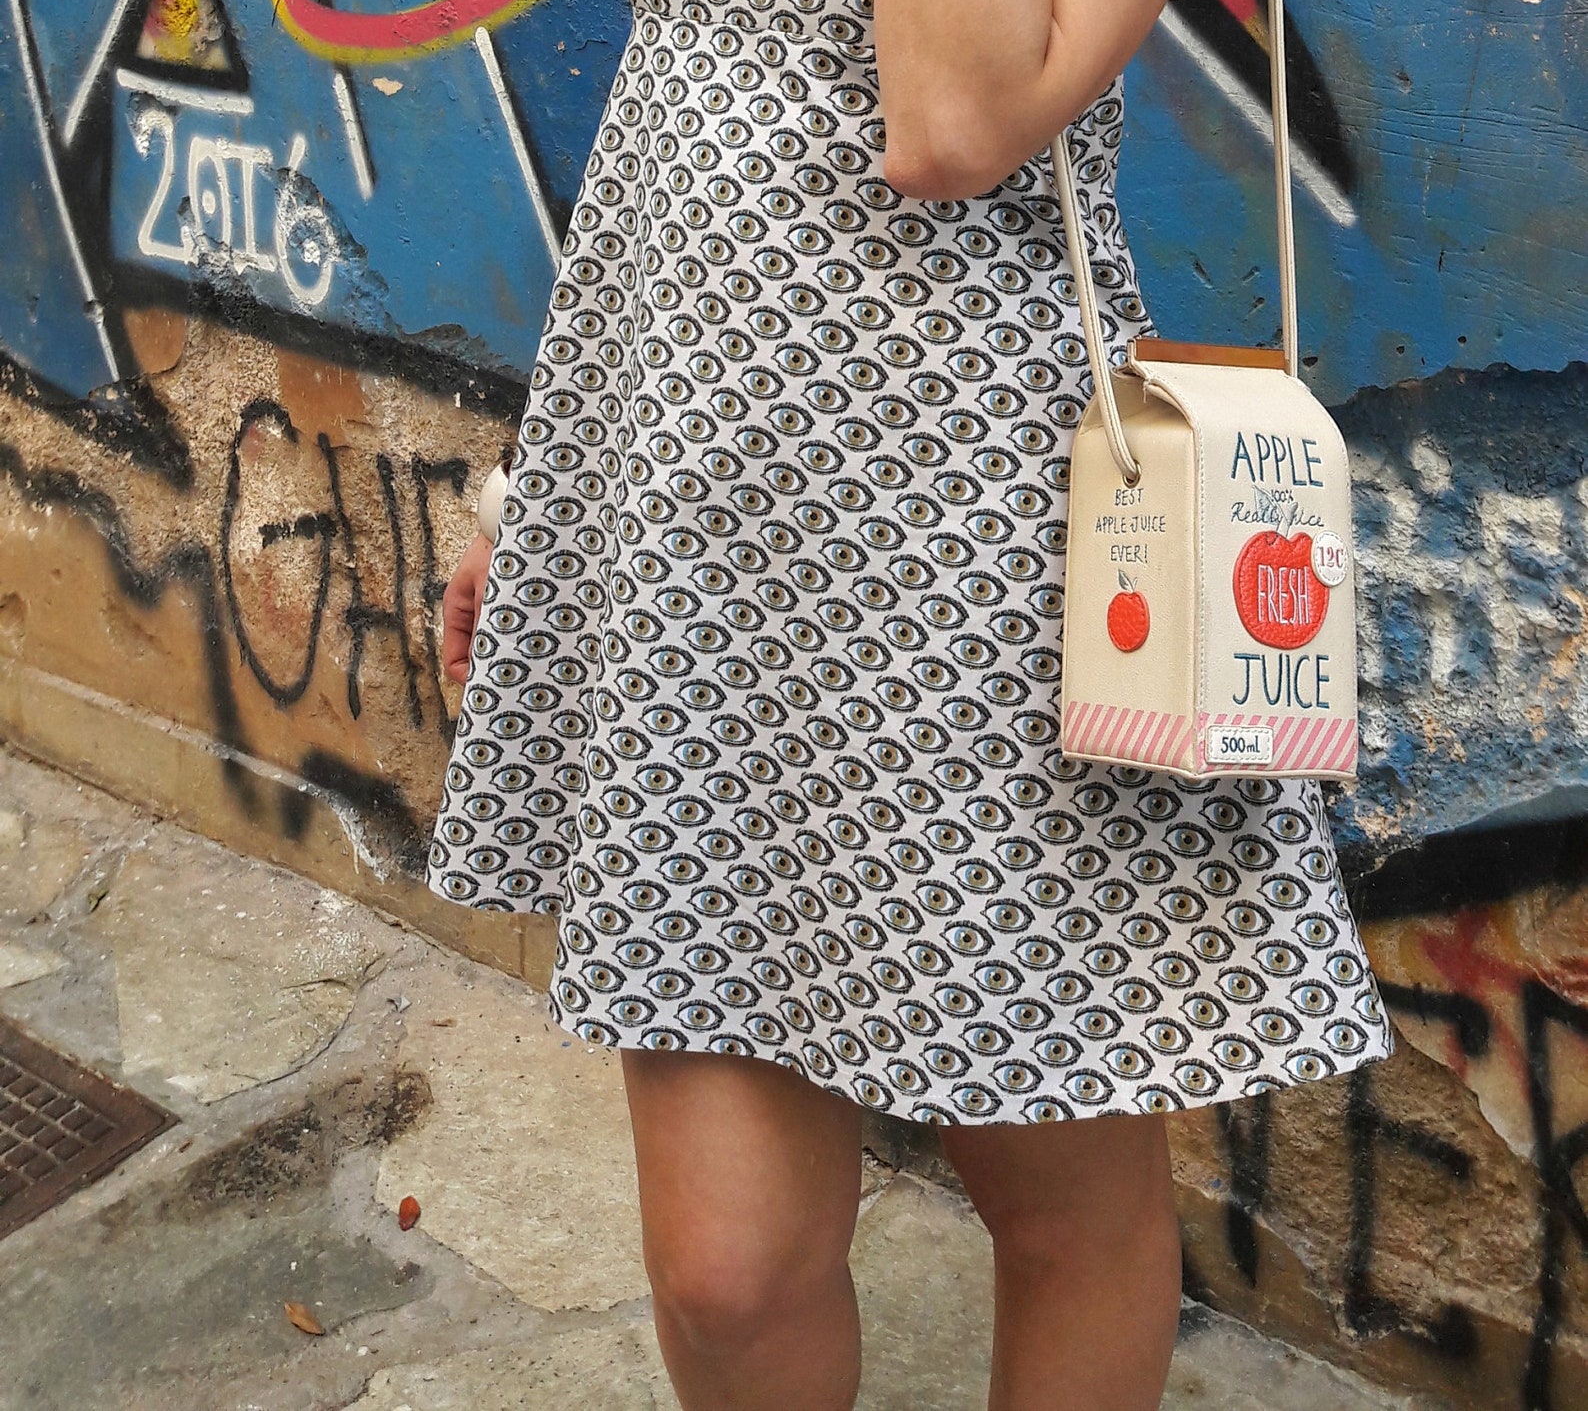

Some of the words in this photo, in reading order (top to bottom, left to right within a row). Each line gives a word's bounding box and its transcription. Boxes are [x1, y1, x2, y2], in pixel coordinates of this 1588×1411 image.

[1230, 431, 1324, 487] APPLE
[1114, 488, 1144, 506] BEST
[1095, 515, 1127, 534] APPLE
[1130, 514, 1166, 533] JUICE
[1110, 543, 1148, 564] EVER!
[1257, 562, 1310, 625] FRESH
[1232, 653, 1330, 709] JUICE
[1220, 735, 1260, 754] 500ml
